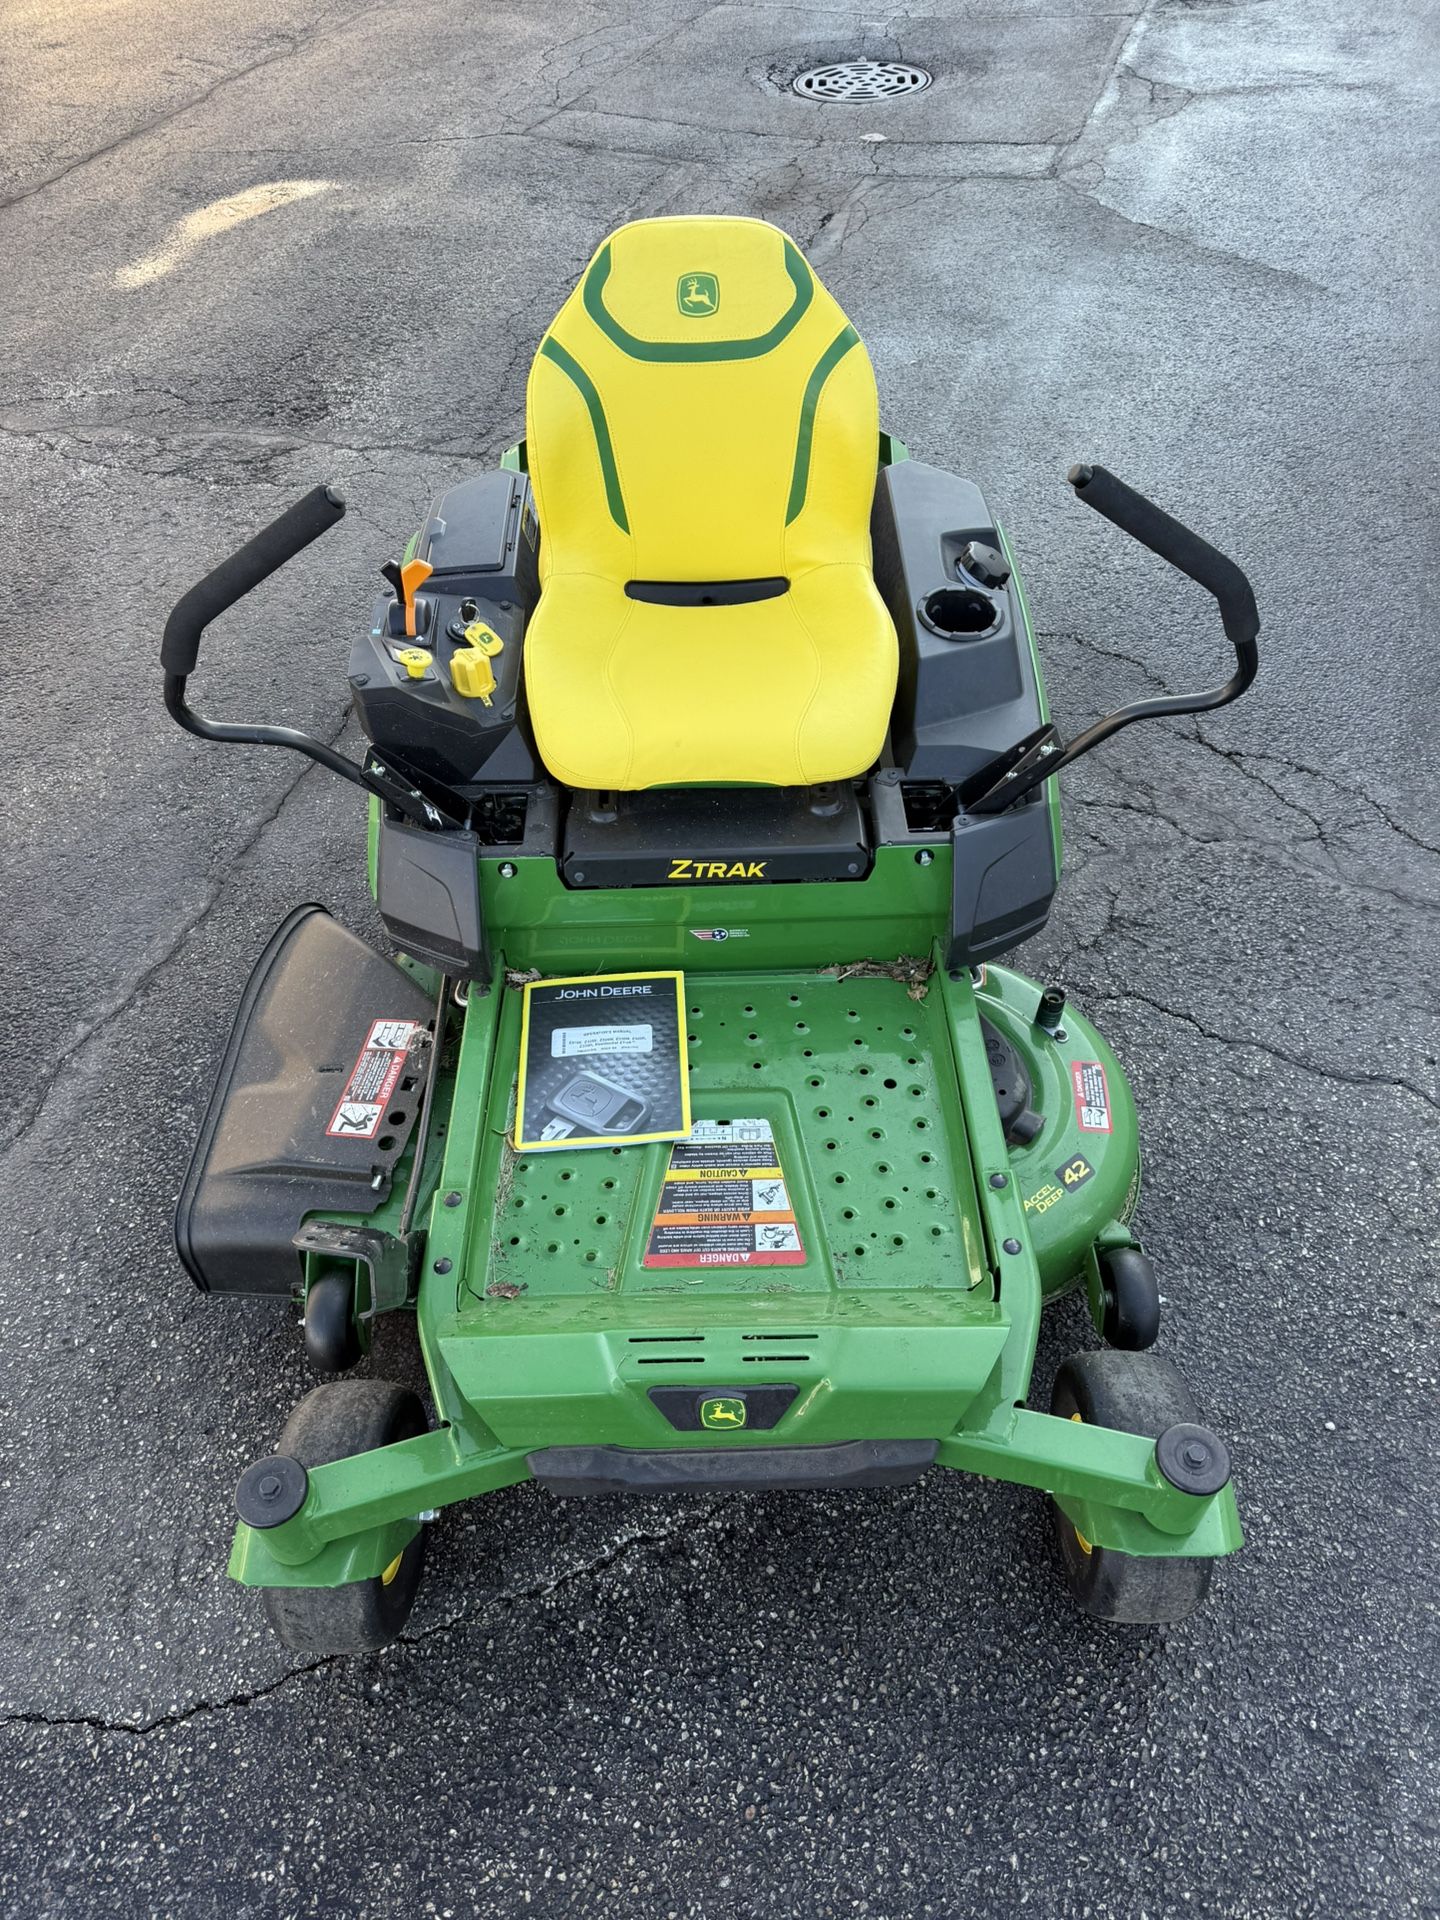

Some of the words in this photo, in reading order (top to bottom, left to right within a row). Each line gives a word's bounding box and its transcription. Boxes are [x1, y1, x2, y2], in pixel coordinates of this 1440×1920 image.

[668, 859, 768, 879] ZTRAK
[555, 989, 598, 1000] JOHN
[600, 985, 653, 997] DEERE
[380, 1064, 400, 1098] DANGER
[700, 1169, 738, 1178] CAUTION
[1064, 1160, 1090, 1185] 42
[1023, 1184, 1055, 1212] ACCEL
[1035, 1188, 1064, 1214] DEEP
[697, 1212, 740, 1222] WARNING
[699, 1253, 739, 1263] DANGER
